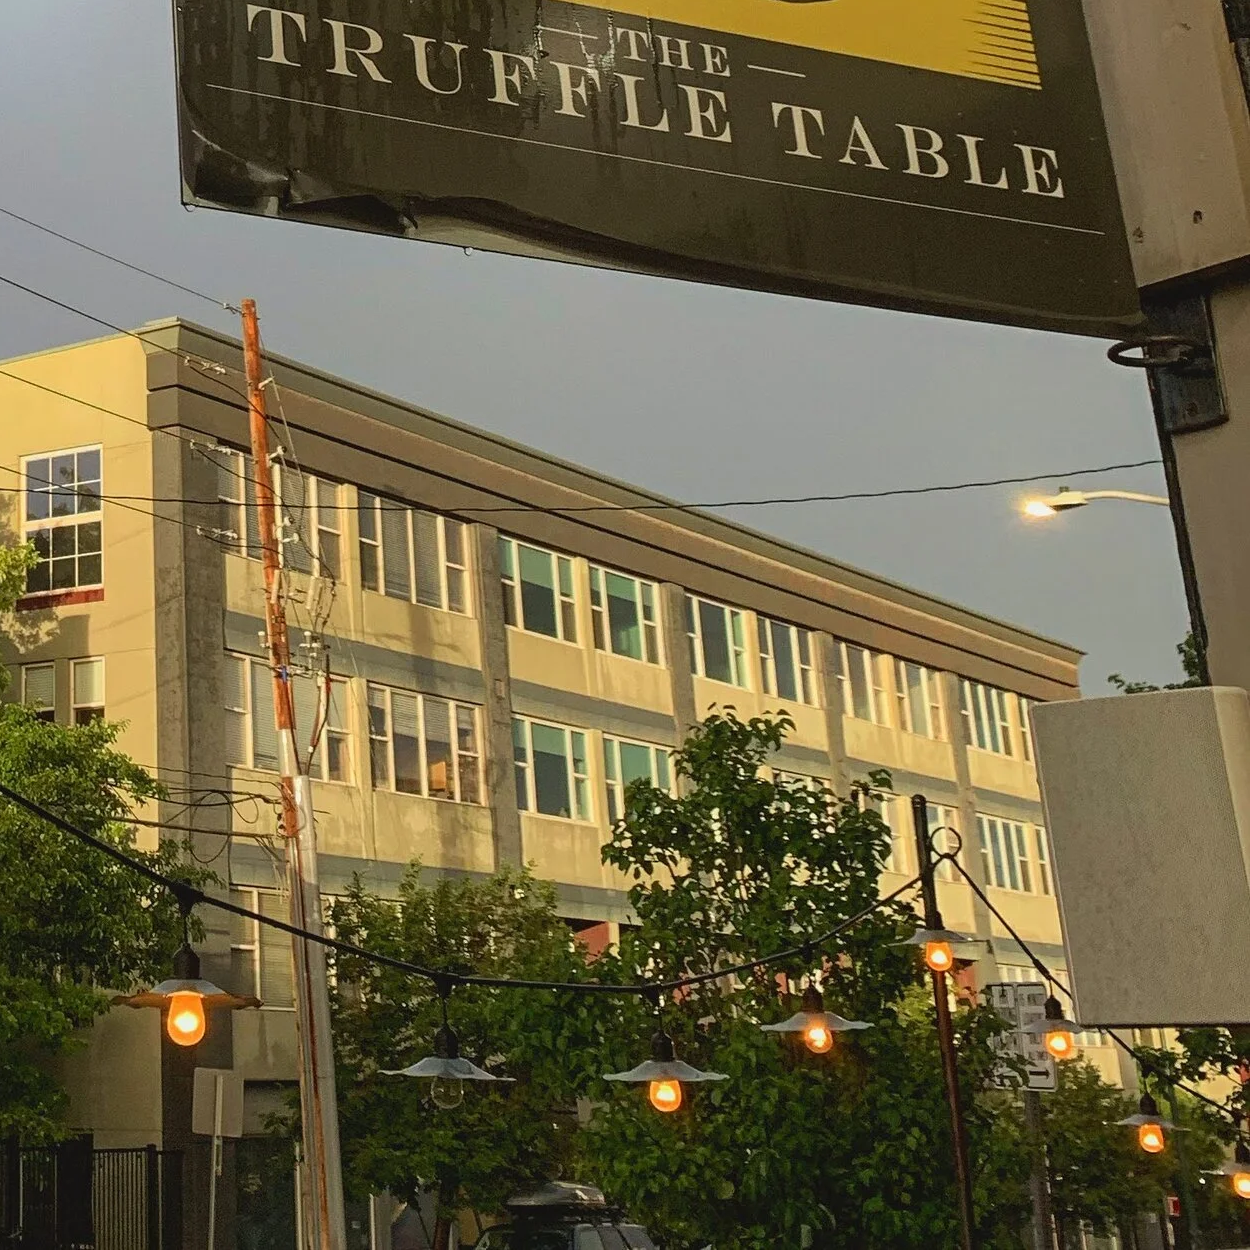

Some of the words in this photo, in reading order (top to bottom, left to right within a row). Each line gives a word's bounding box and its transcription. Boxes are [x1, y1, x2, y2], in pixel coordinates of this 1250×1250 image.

[246, 3, 733, 144] TRUFFLE
[771, 102, 1065, 200] TABLE
[615, 27, 731, 78] THE
